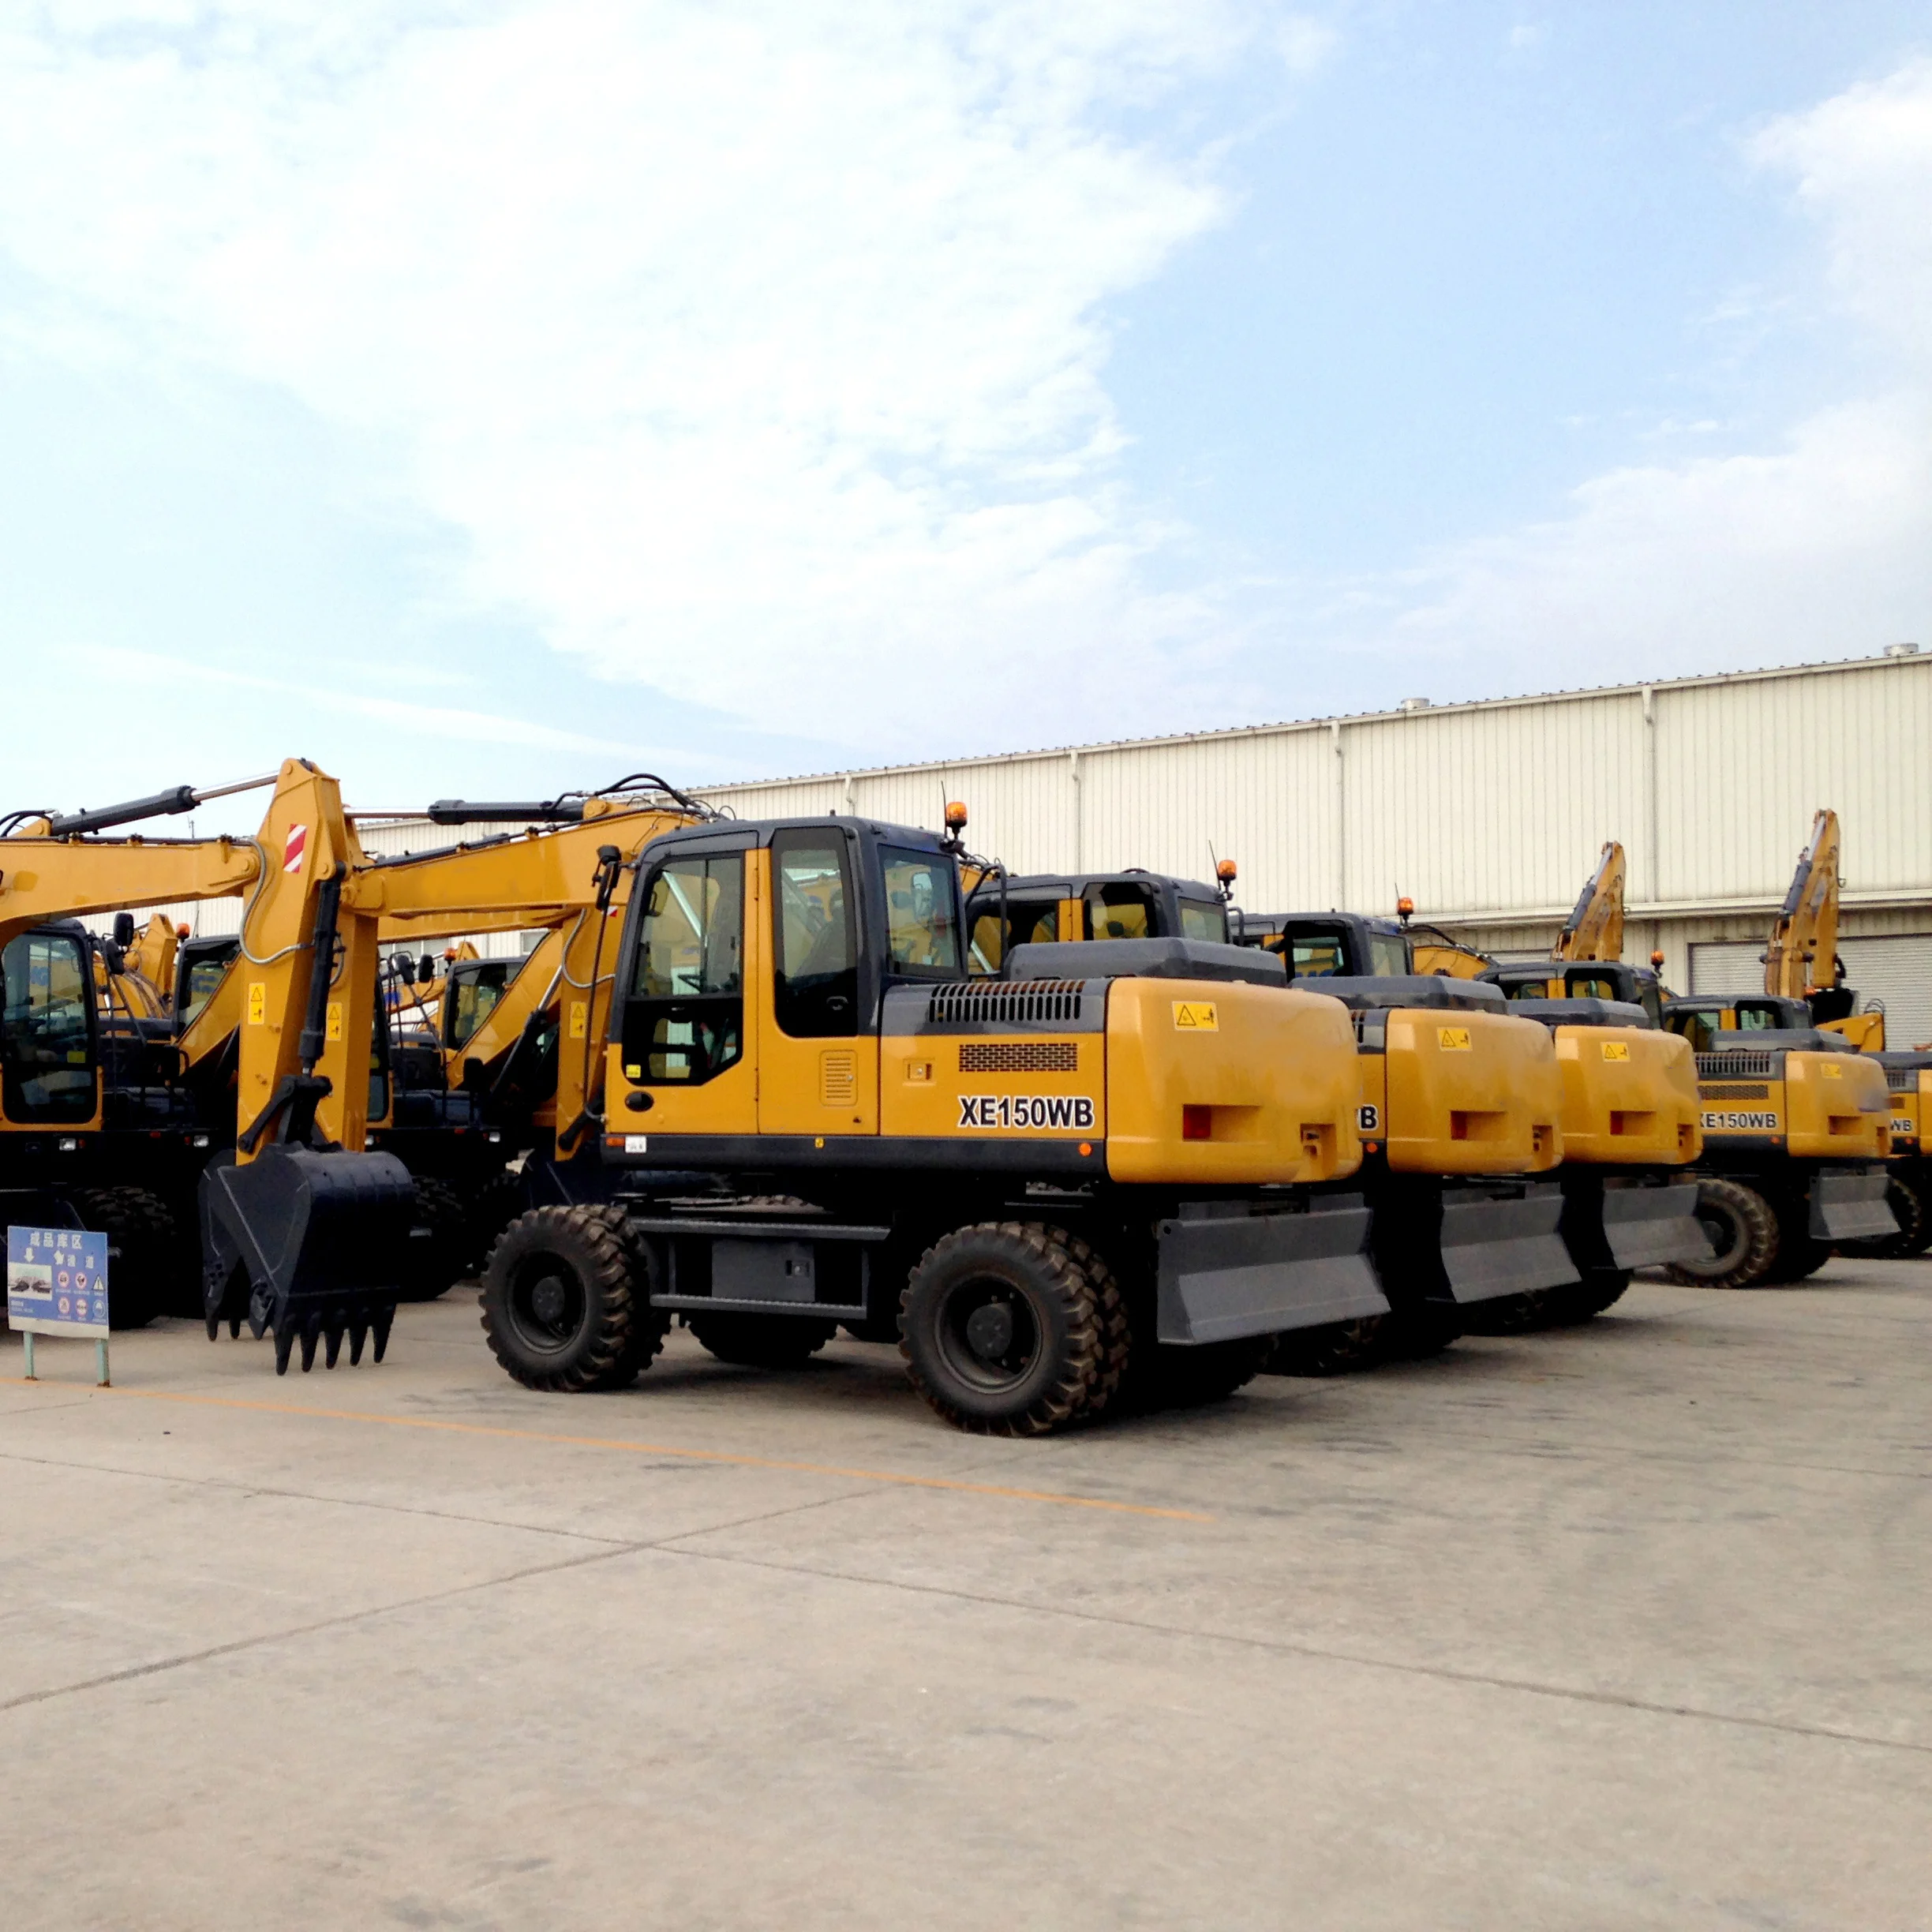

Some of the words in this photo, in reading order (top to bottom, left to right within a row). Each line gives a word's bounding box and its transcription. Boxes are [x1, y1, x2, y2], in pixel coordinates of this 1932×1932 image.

[958, 1096, 1094, 1129] XE150WB
[30, 1231, 82, 1249] 成品库区
